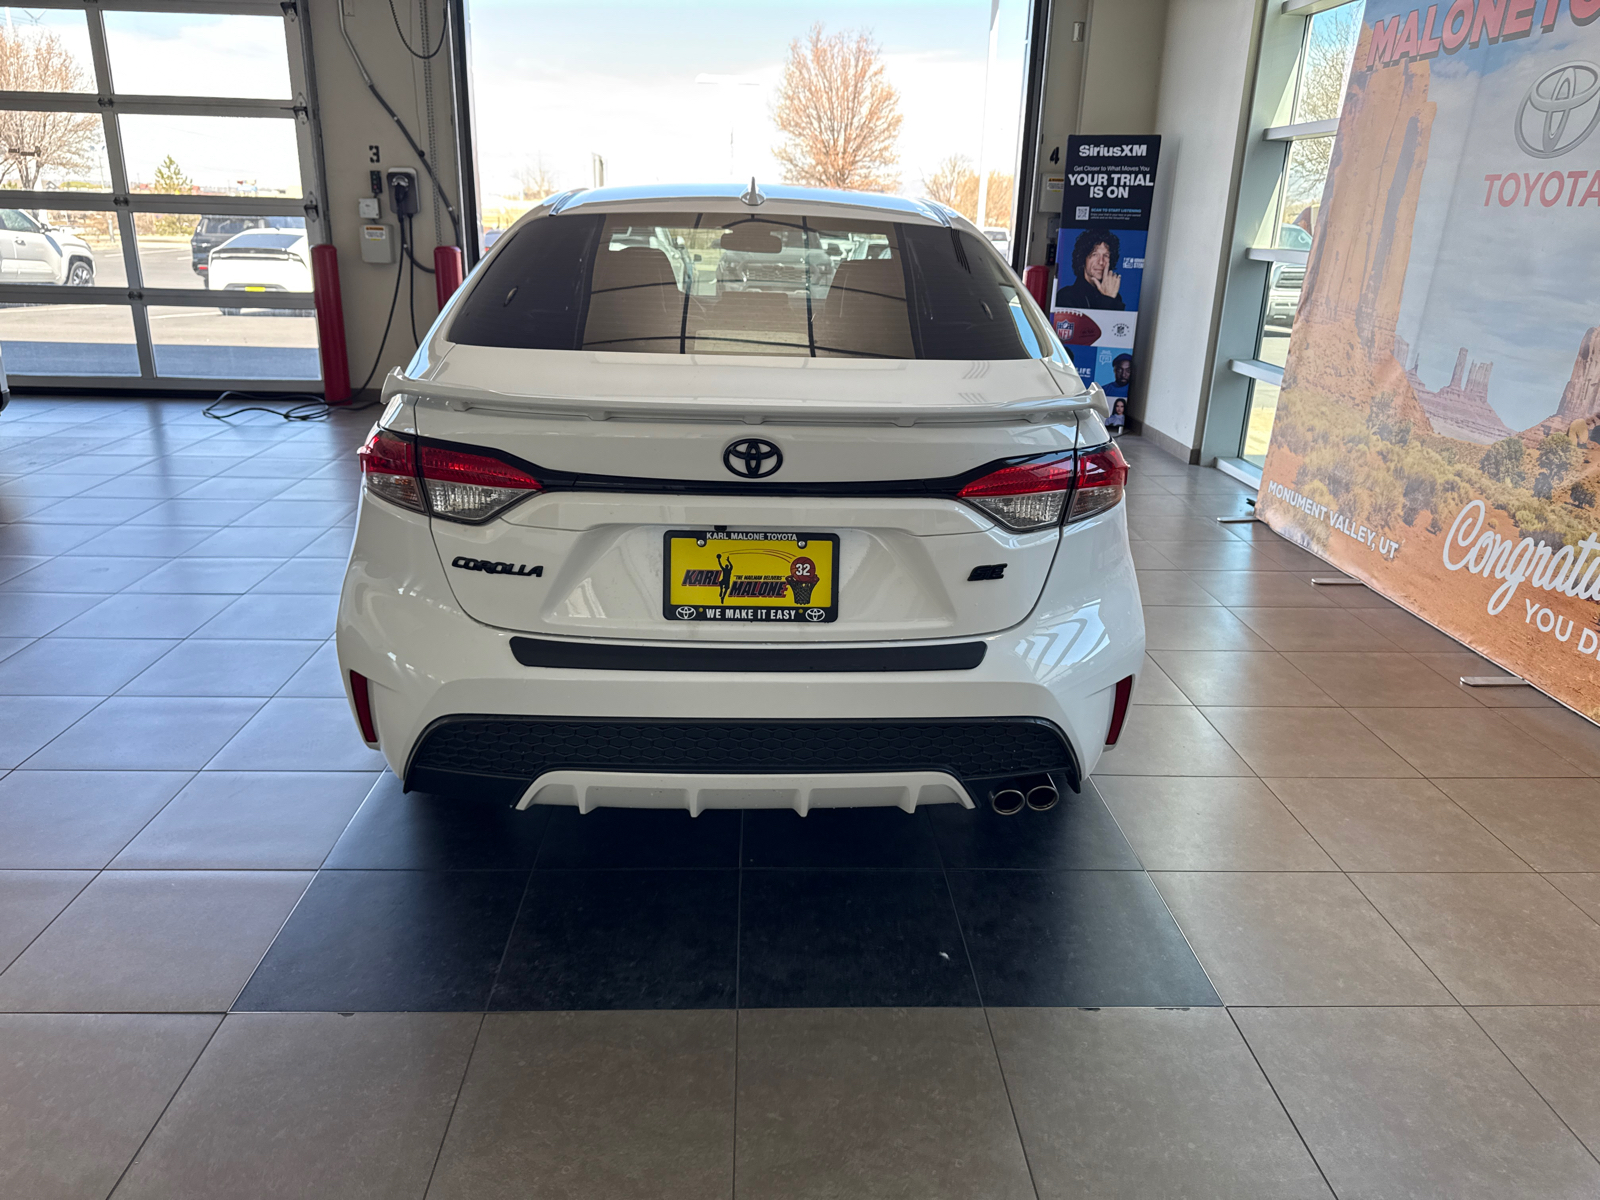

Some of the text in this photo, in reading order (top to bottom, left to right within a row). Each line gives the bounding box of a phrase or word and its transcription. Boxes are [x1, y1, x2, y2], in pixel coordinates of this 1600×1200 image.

[1366, 0, 1535, 71] MALONE
[369, 145, 380, 163] 3
[1050, 146, 1060, 165] 4
[1079, 144, 1147, 157] SiriusXM
[1068, 173, 1108, 186] YOUR
[1111, 173, 1154, 187] TRIAL
[1089, 186, 1129, 198] IS ON
[1484, 170, 1600, 208] TOYOTA
[1058, 329, 1072, 339] NFL
[1268, 480, 1399, 559] MONUMENT VALLEY, UT
[706, 532, 729, 540] KARL
[452, 556, 544, 577] COROLLA
[795, 563, 811, 576] 32
[682, 570, 722, 586] KARL
[728, 580, 789, 598] MALONE
[706, 609, 796, 620] WE MAKE IT EASY
[1525, 598, 1600, 662] YOU D
